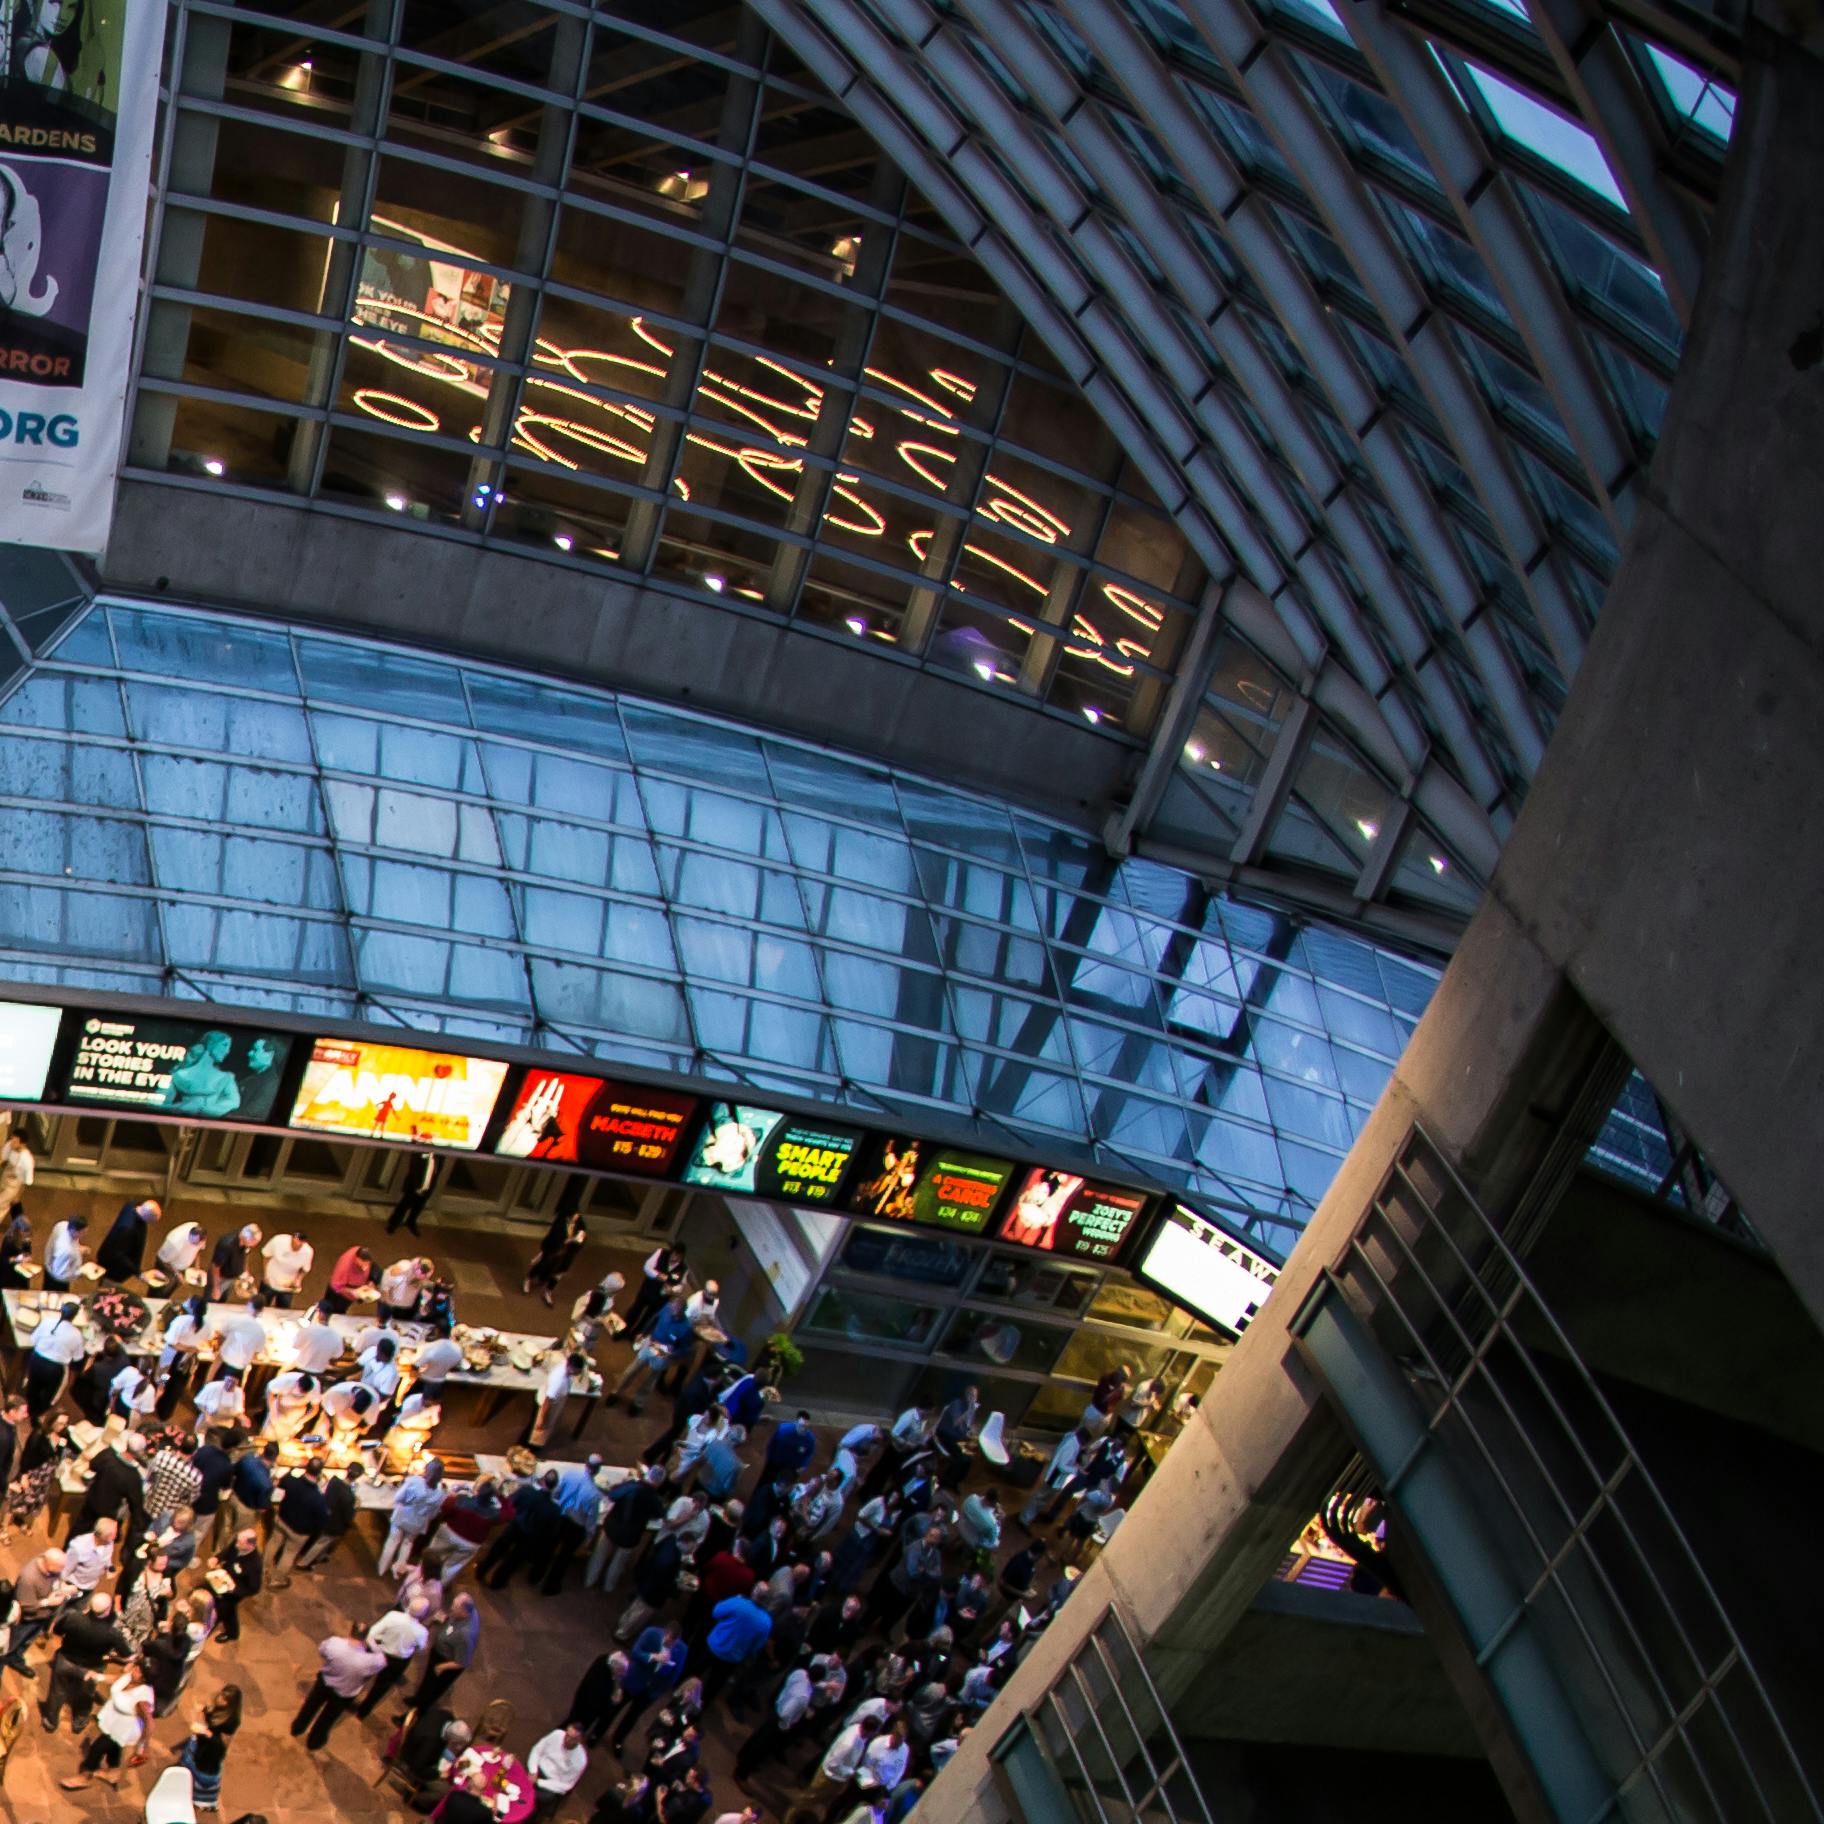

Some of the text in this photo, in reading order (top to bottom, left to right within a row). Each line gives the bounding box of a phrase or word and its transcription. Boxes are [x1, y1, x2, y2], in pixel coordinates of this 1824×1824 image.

[81, 1036, 187, 1062] LOOK YOUR
[77, 1052, 154, 1073] STORIES
[72, 1066, 173, 1090] IN THE EYE
[315, 1068, 480, 1116] ANNIE
[589, 1115, 678, 1143] MACBETH
[776, 1142, 850, 1169] SMART
[776, 1160, 842, 1184] PEOPLE
[936, 1184, 993, 1208] CAROL
[1067, 1209, 1128, 1234] PERFECT
